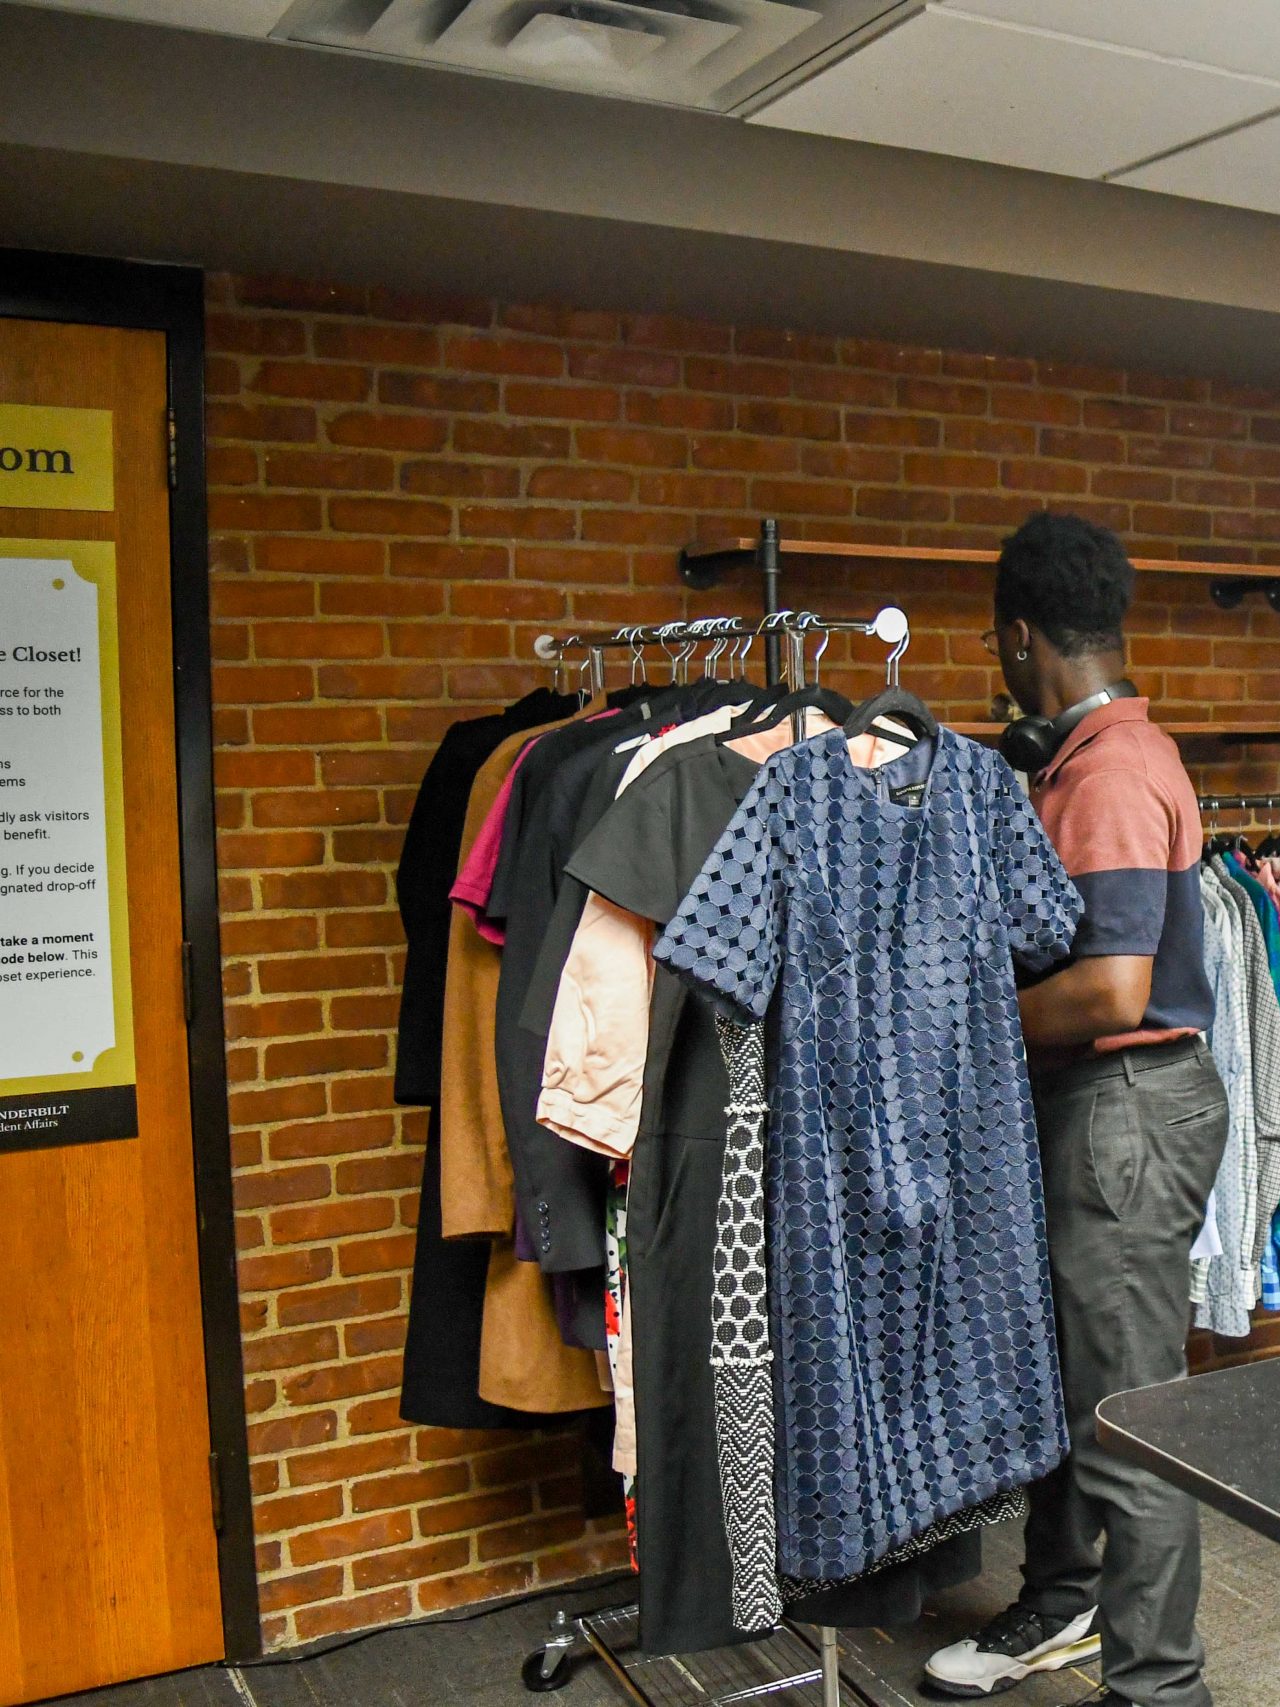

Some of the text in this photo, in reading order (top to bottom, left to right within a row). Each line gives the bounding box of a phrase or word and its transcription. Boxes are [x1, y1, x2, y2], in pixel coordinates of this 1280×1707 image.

[0, 447, 75, 474] om
[12, 646, 81, 662] Closet!
[23, 686, 41, 698] for
[44, 687, 64, 698] the
[17, 705, 30, 716] to
[33, 704, 61, 716] both
[19, 811, 42, 822] ask
[44, 810, 90, 821] visitors
[3, 828, 51, 840] benefit.
[16, 864, 25, 875] If
[28, 866, 50, 878] you
[53, 862, 95, 874] decide
[0, 879, 97, 896] gnated drop-off
[0, 932, 95, 947] take a moment
[27, 951, 69, 963] below.
[72, 949, 98, 960] This
[25, 968, 96, 982] experience.
[23, 1118, 59, 1130] Affairs
